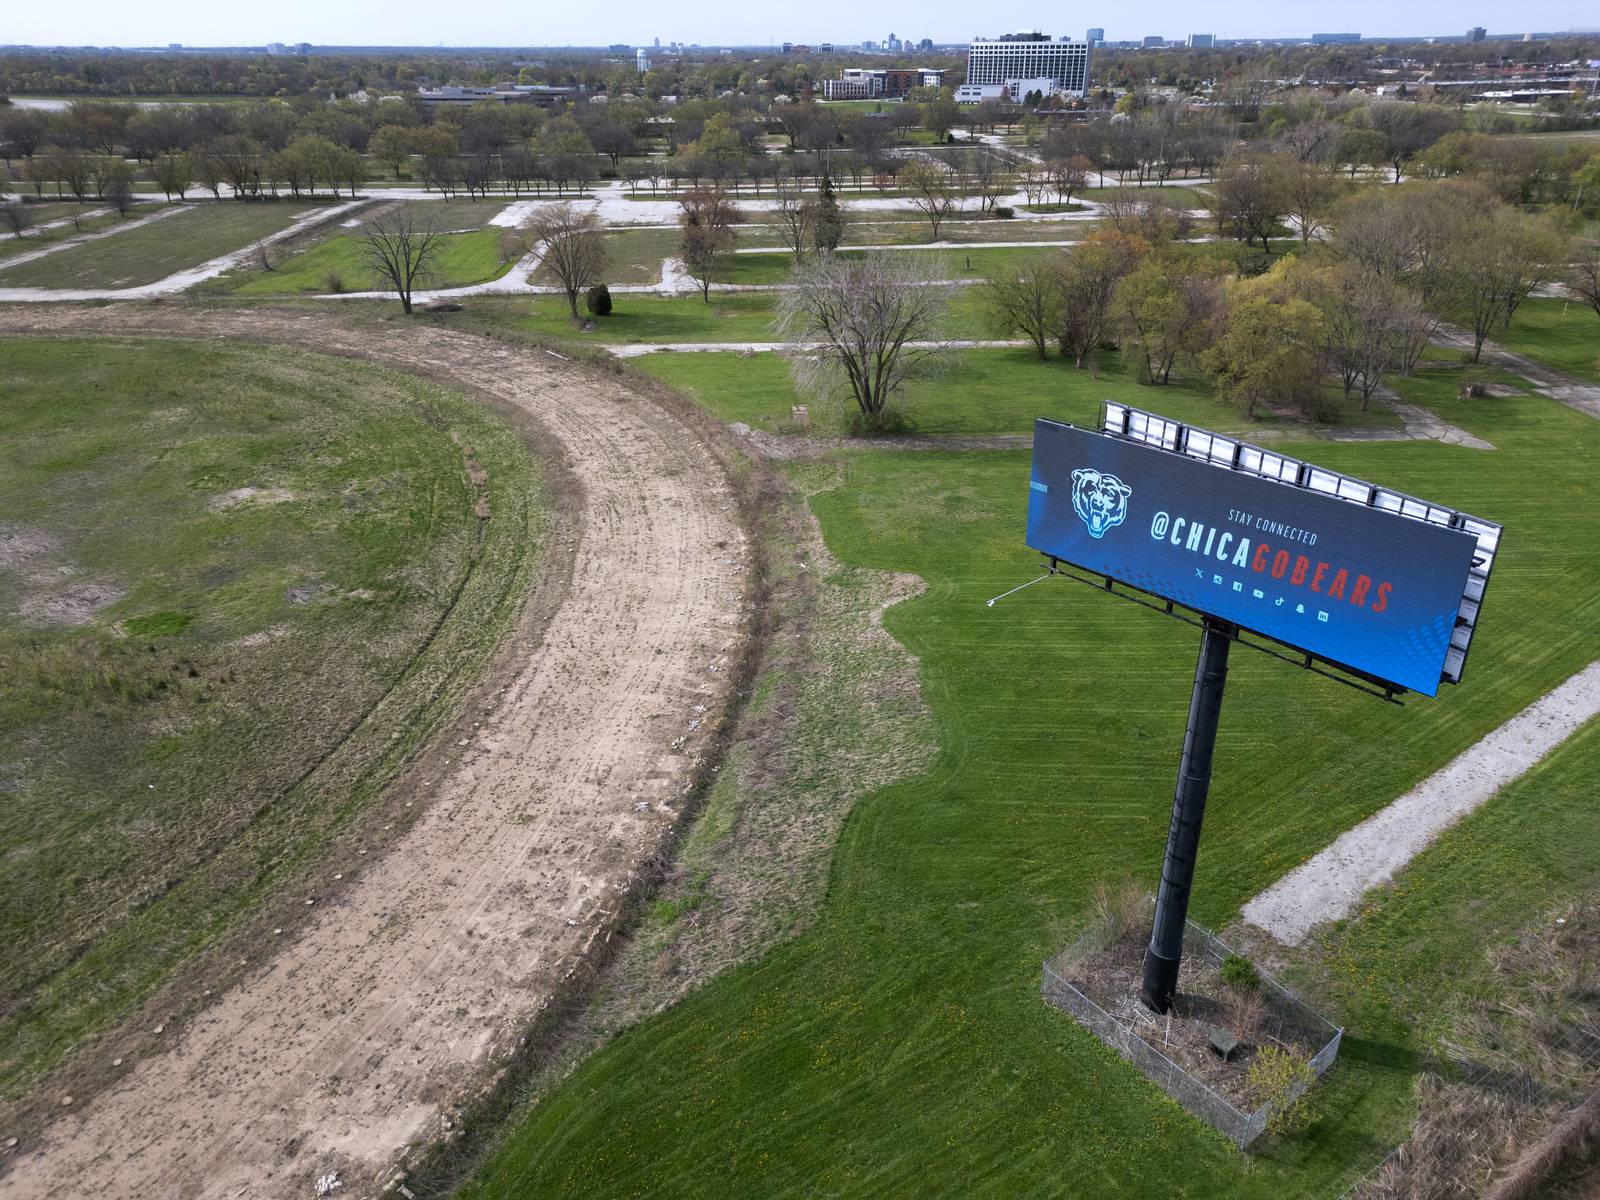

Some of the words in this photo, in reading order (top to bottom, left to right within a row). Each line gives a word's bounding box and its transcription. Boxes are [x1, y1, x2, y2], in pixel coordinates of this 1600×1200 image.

[1151, 511, 1393, 613] @CHICAGOBEARS
[1228, 509, 1252, 525] STAY
[1256, 517, 1318, 546] CONNECTED
